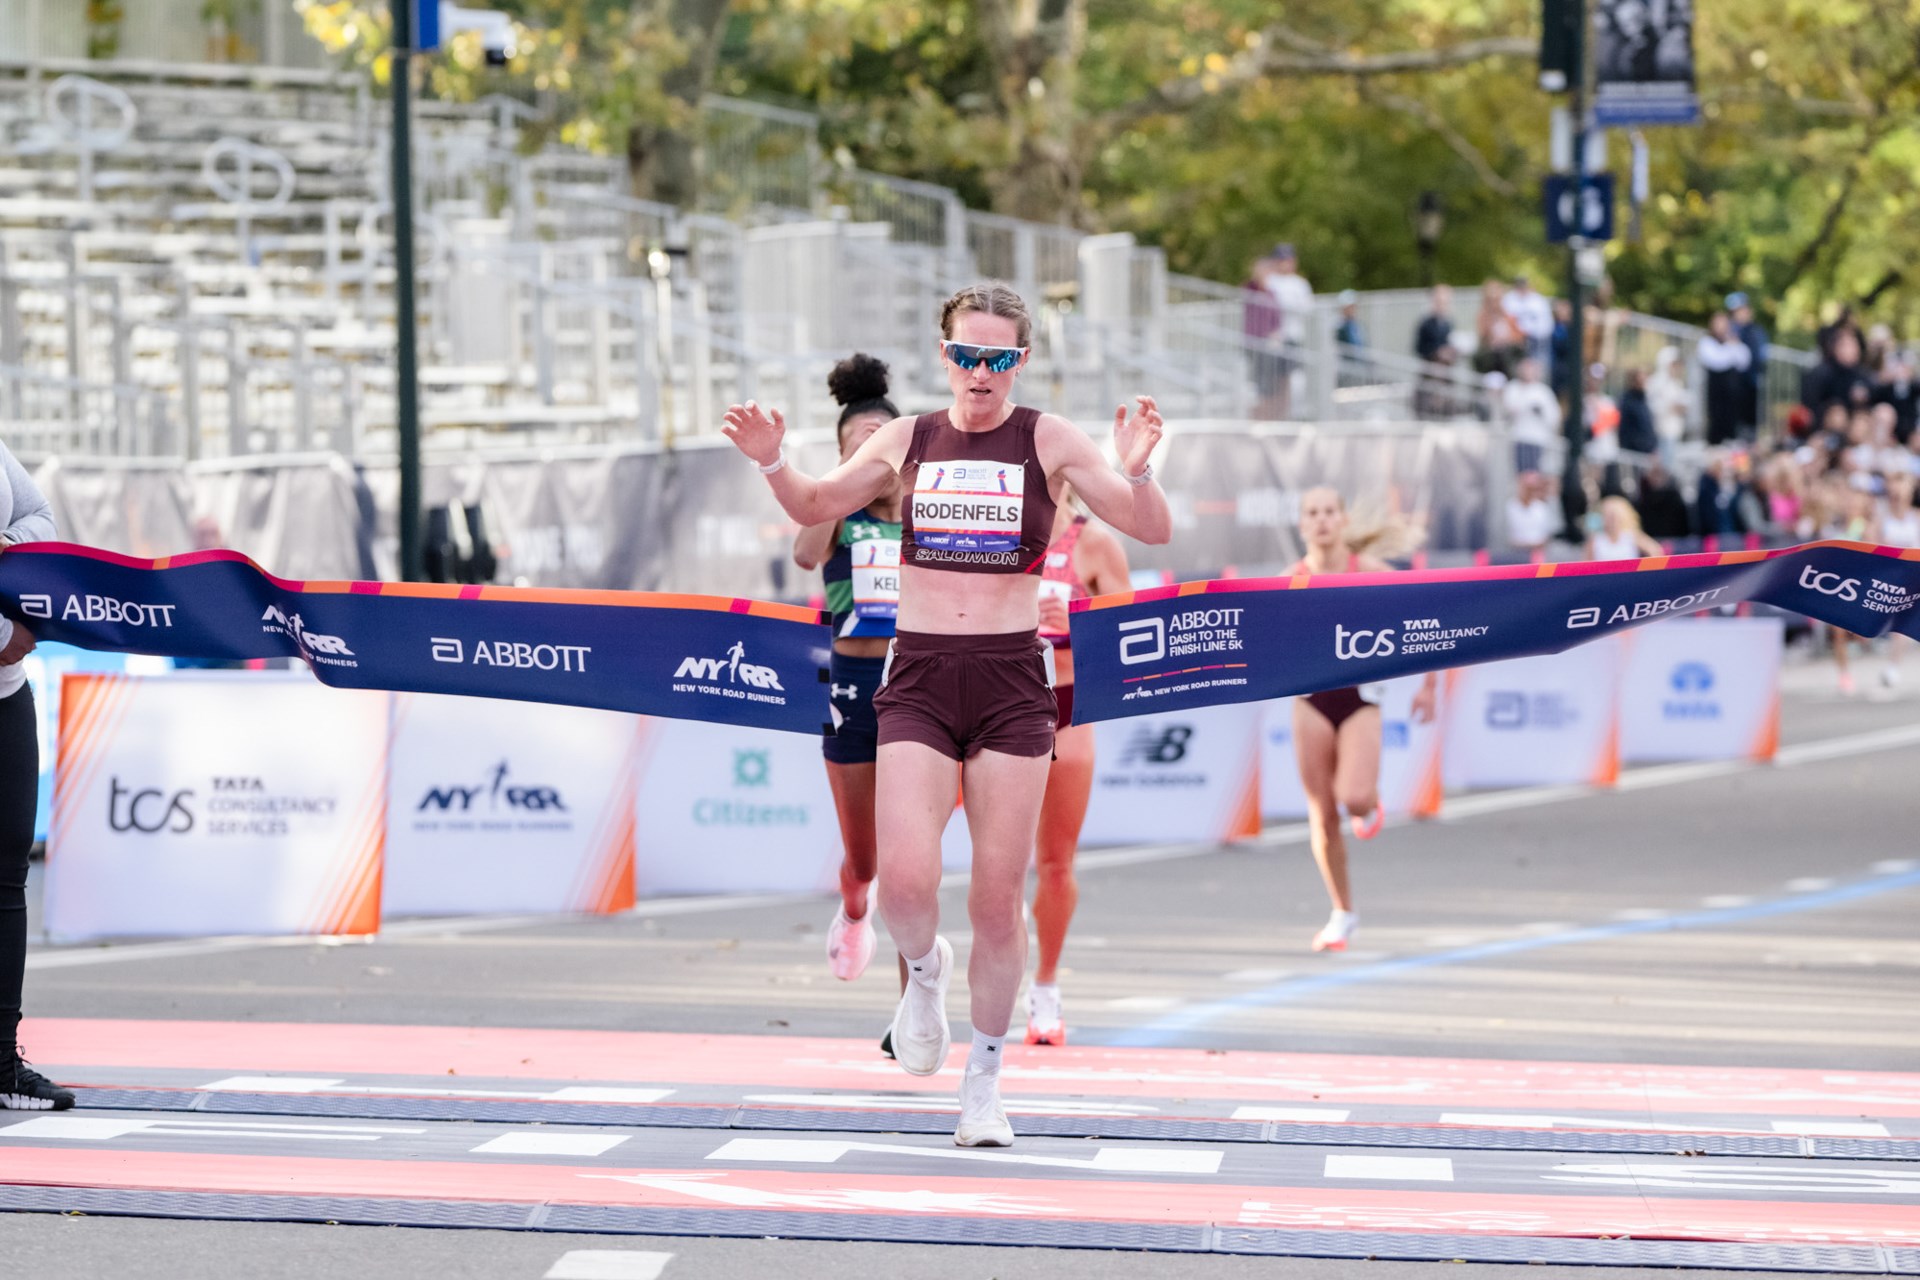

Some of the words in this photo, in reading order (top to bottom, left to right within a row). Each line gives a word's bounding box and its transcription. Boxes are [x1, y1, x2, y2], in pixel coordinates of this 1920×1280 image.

[915, 502, 1018, 522] RODENFELS
[915, 549, 1019, 566] SALOMON
[1799, 565, 1861, 601] tcs
[1871, 578, 1906, 595] TATA
[62, 594, 175, 627] ABBOTT
[1606, 586, 1728, 624] ABBOTT
[1862, 599, 1914, 613] SERVICES
[262, 625, 284, 633] NEW
[1168, 608, 1244, 632] ABBOTT
[1403, 619, 1440, 630] TATA
[1169, 632, 1196, 646] DASH
[1198, 630, 1213, 641] TO
[1214, 629, 1237, 640] THE
[1335, 623, 1395, 660] tcs
[1402, 625, 1489, 643] CONSULTANCY
[472, 640, 592, 672] ABBOTT
[1169, 642, 1201, 657] FINISH
[1202, 641, 1226, 652] LINE
[1228, 639, 1243, 650] 5K
[1401, 640, 1456, 655] SERVICES
[316, 655, 358, 668] RUNNERS
[673, 656, 785, 691] NYRR
[672, 684, 696, 693] NEW
[697, 685, 721, 696] YORK
[723, 688, 745, 699] ROAD
[747, 692, 786, 705] RUNNERS
[1154, 687, 1171, 696] NEW
[1171, 684, 1190, 693] YORK
[1190, 681, 1210, 690] ROAD
[1211, 678, 1247, 687] RUNNERS
[212, 777, 265, 791] TATA
[109, 776, 195, 833] tcs
[691, 797, 811, 827] Citizens
